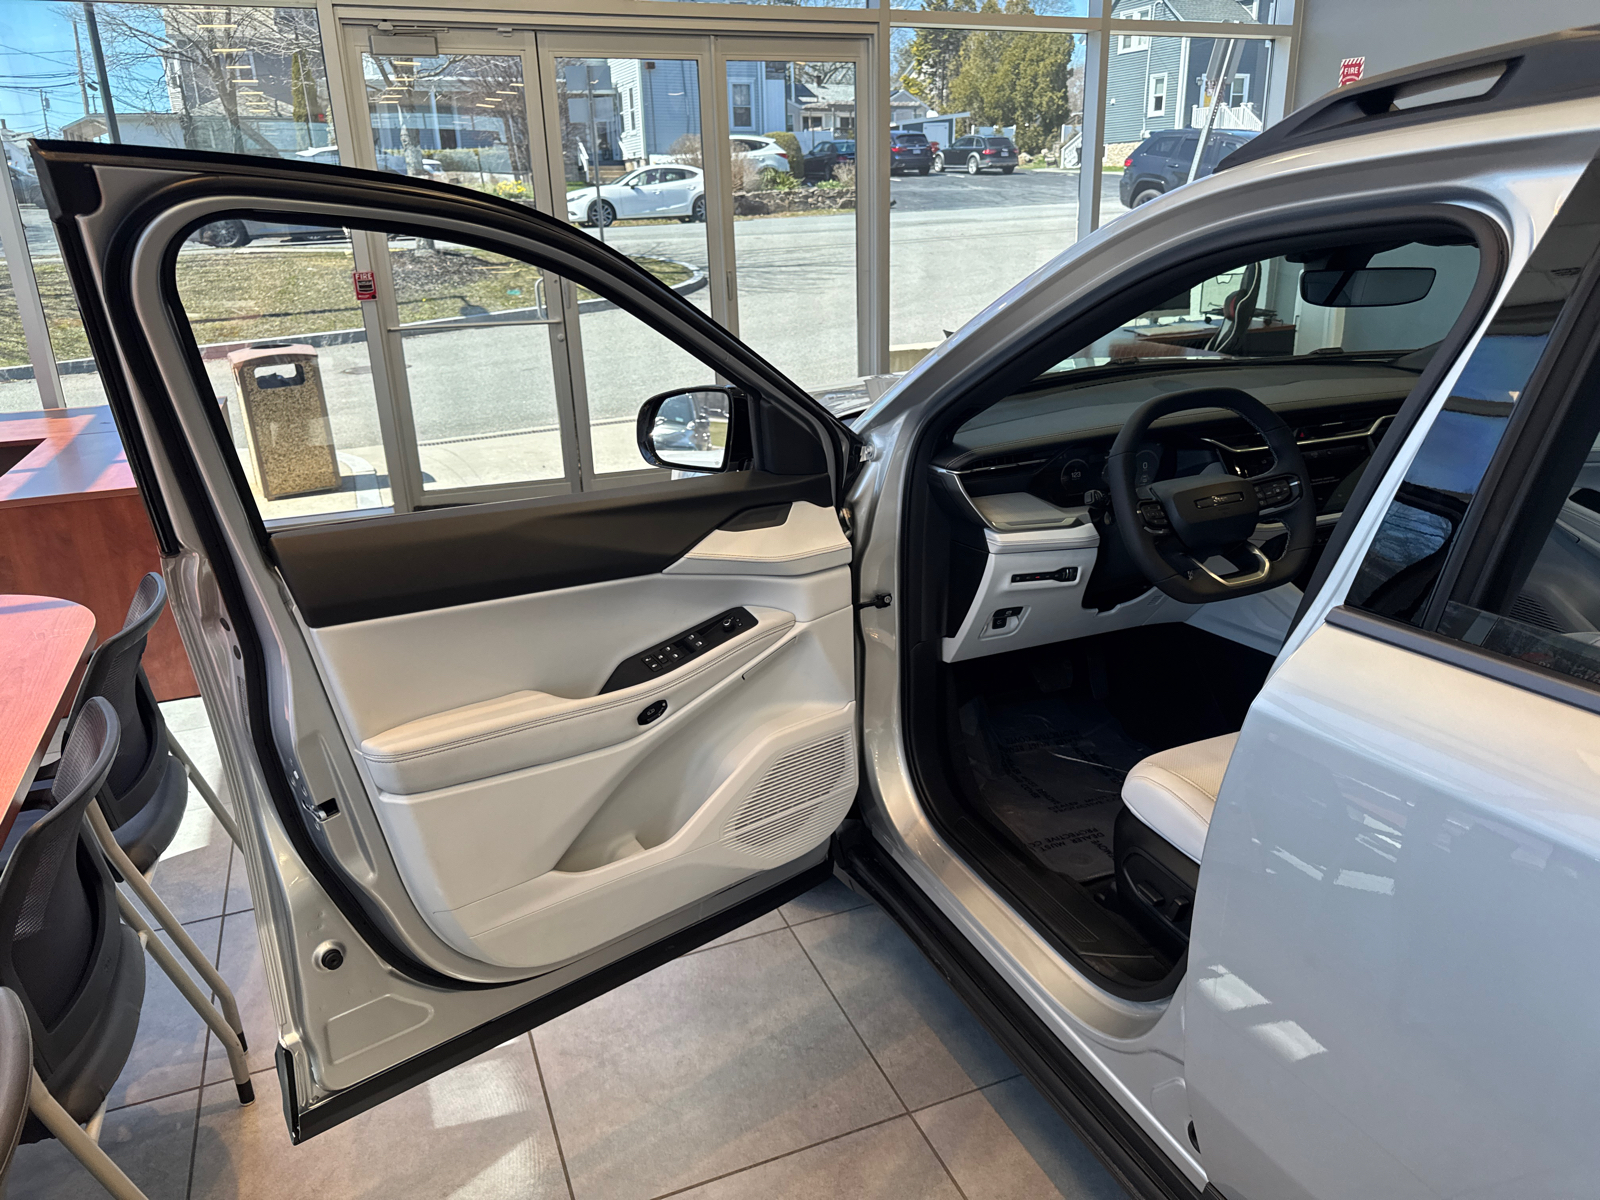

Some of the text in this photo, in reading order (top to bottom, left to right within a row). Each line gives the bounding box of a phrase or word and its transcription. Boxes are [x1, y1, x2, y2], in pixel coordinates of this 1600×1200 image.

[1344, 66, 1359, 75] FIRE
[355, 272, 373, 280] FIRE
[1044, 827, 1099, 843] PROTECTIVE
[1040, 832, 1105, 852] DEALER MUST
